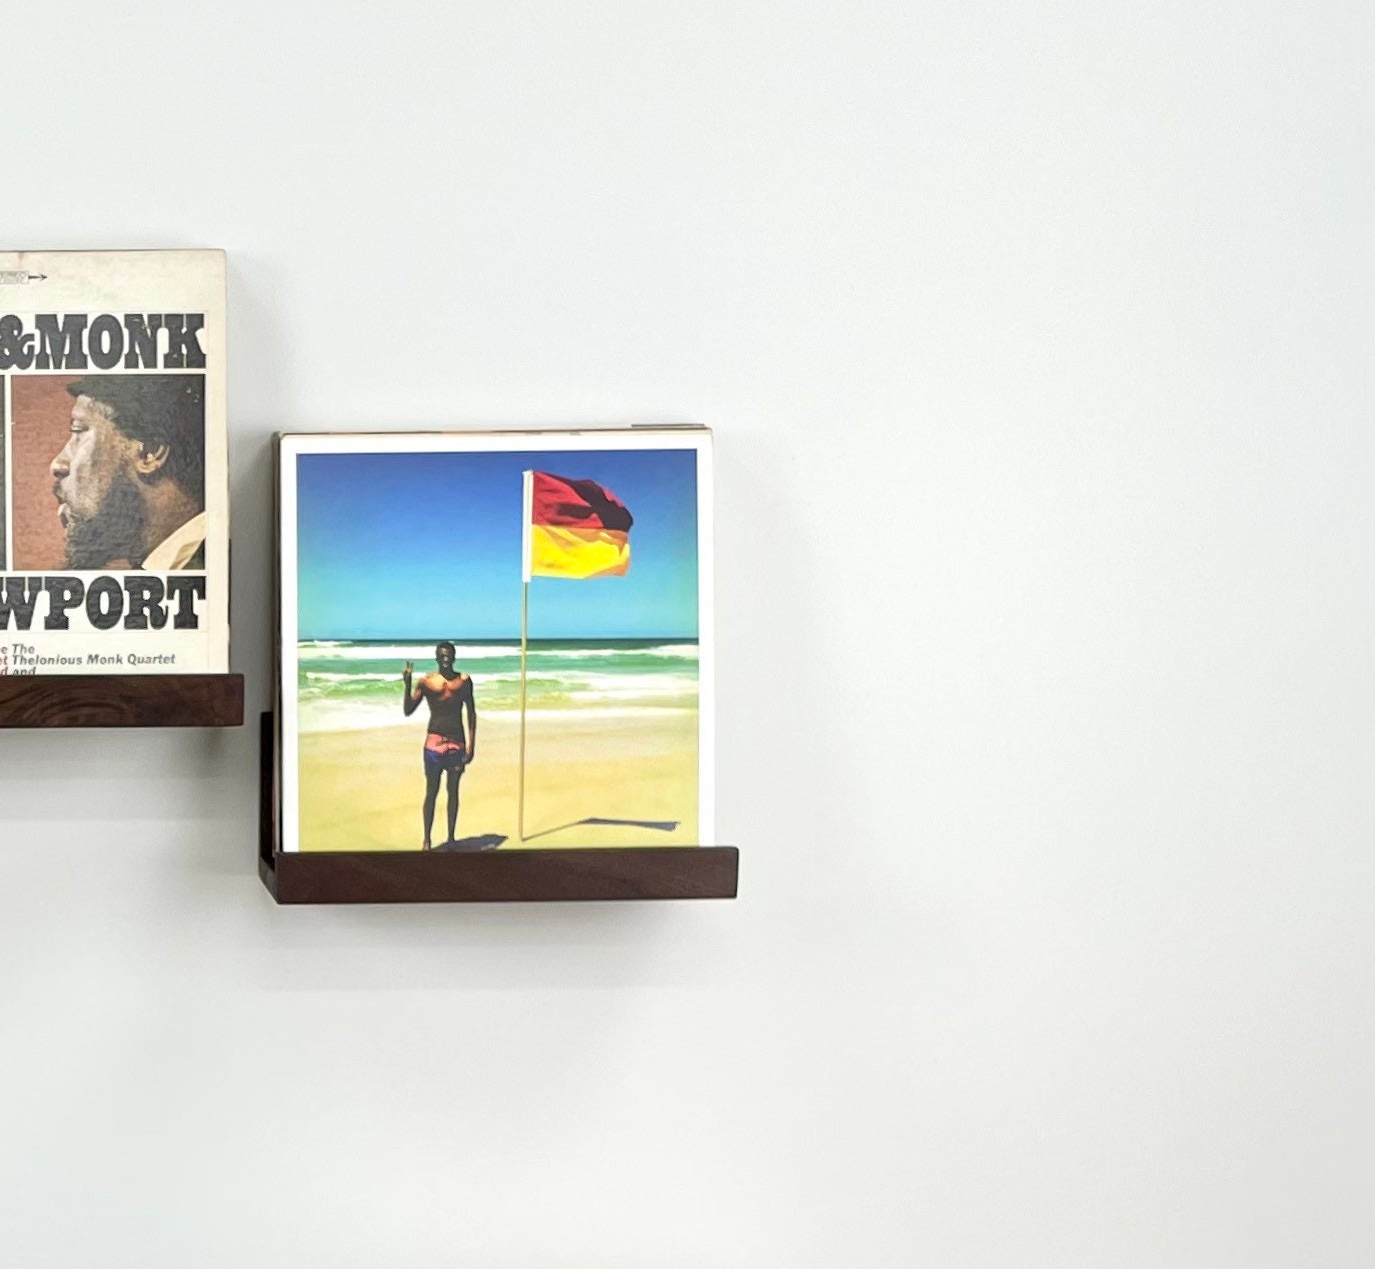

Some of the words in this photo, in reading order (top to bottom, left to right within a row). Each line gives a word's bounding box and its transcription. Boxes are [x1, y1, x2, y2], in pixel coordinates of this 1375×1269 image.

[12, 643, 35, 655] The
[12, 654, 83, 666] Thelonious
[86, 653, 123, 665] Monk
[127, 653, 176, 666] Quartet
